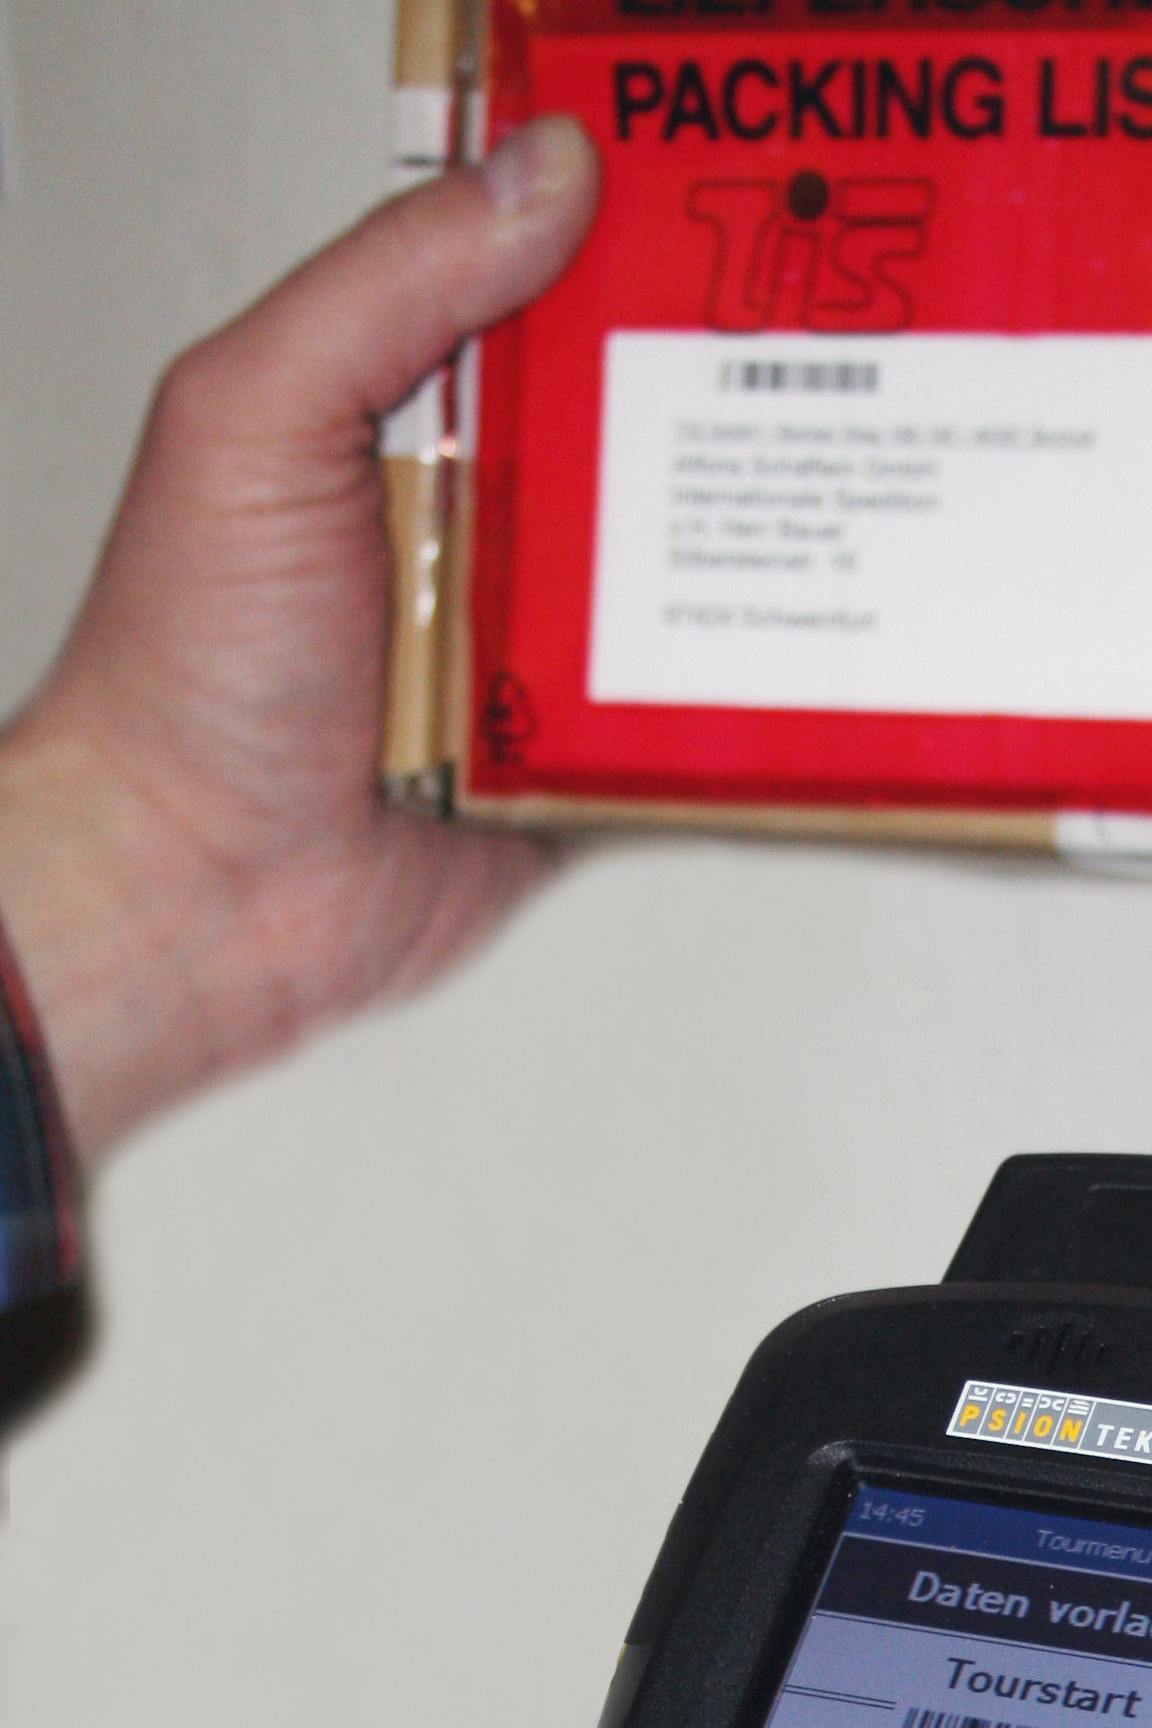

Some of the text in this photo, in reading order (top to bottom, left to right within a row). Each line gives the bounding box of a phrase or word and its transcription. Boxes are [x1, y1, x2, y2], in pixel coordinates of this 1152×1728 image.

[613, 57, 1005, 141] PACKING
[958, 1403, 1083, 1443] PSION
[858, 1503, 927, 1529] 14:45
[908, 1571, 1029, 1619] Daten
[946, 1656, 1143, 1719] Tourstart
